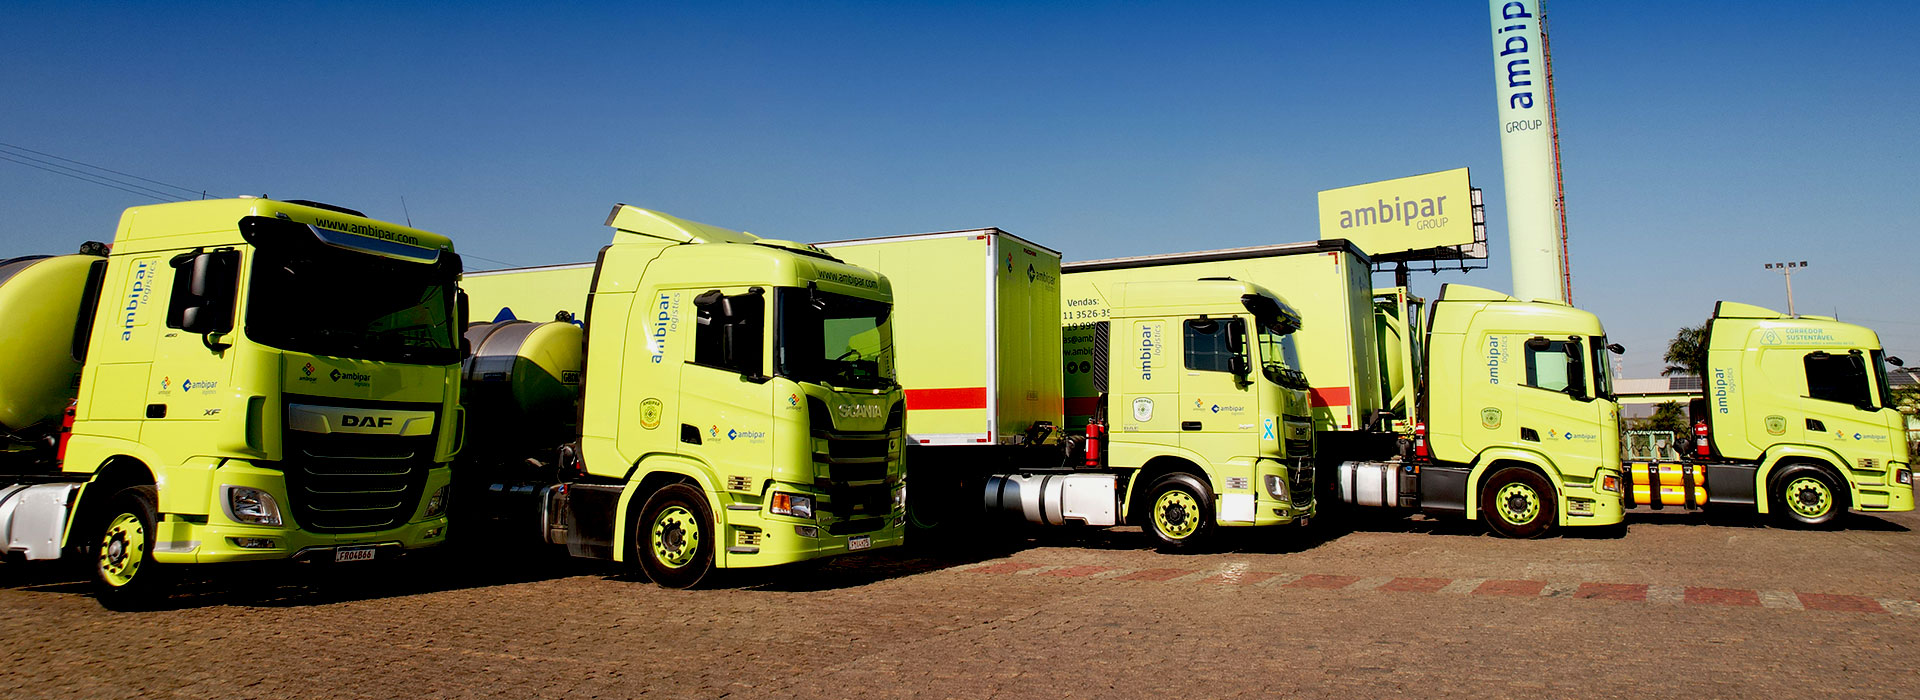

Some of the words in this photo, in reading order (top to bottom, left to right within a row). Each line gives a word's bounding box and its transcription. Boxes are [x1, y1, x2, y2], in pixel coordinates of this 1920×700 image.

[1506, 119, 1542, 133] GROUP
[1340, 195, 1447, 229] ambipar
[316, 218, 419, 246] www.ambipar.com
[1416, 217, 1449, 230] GROUP
[140, 259, 158, 305] logistics
[818, 269, 879, 290] www.ambipar.com
[1036, 271, 1056, 285] ambipar
[121, 261, 148, 342] ambipar
[669, 292, 681, 332] logistics
[1067, 298, 1100, 307] Vendas:
[1063, 311, 1074, 320] 11
[651, 293, 670, 364] ambipar
[1067, 322, 1078, 331] 19
[1153, 324, 1162, 356] logistics
[1501, 335, 1509, 364] logistics
[1140, 325, 1154, 381] ambipar
[1487, 335, 1501, 385] ambipar
[192, 380, 218, 389] ambipar
[341, 371, 371, 382] ambipar
[1728, 367, 1737, 394] logistics
[1714, 367, 1729, 415] ambipar
[203, 408, 222, 416] XF
[341, 414, 393, 428] DAF
[839, 403, 883, 418] SCANIA
[738, 430, 765, 439] ambipar
